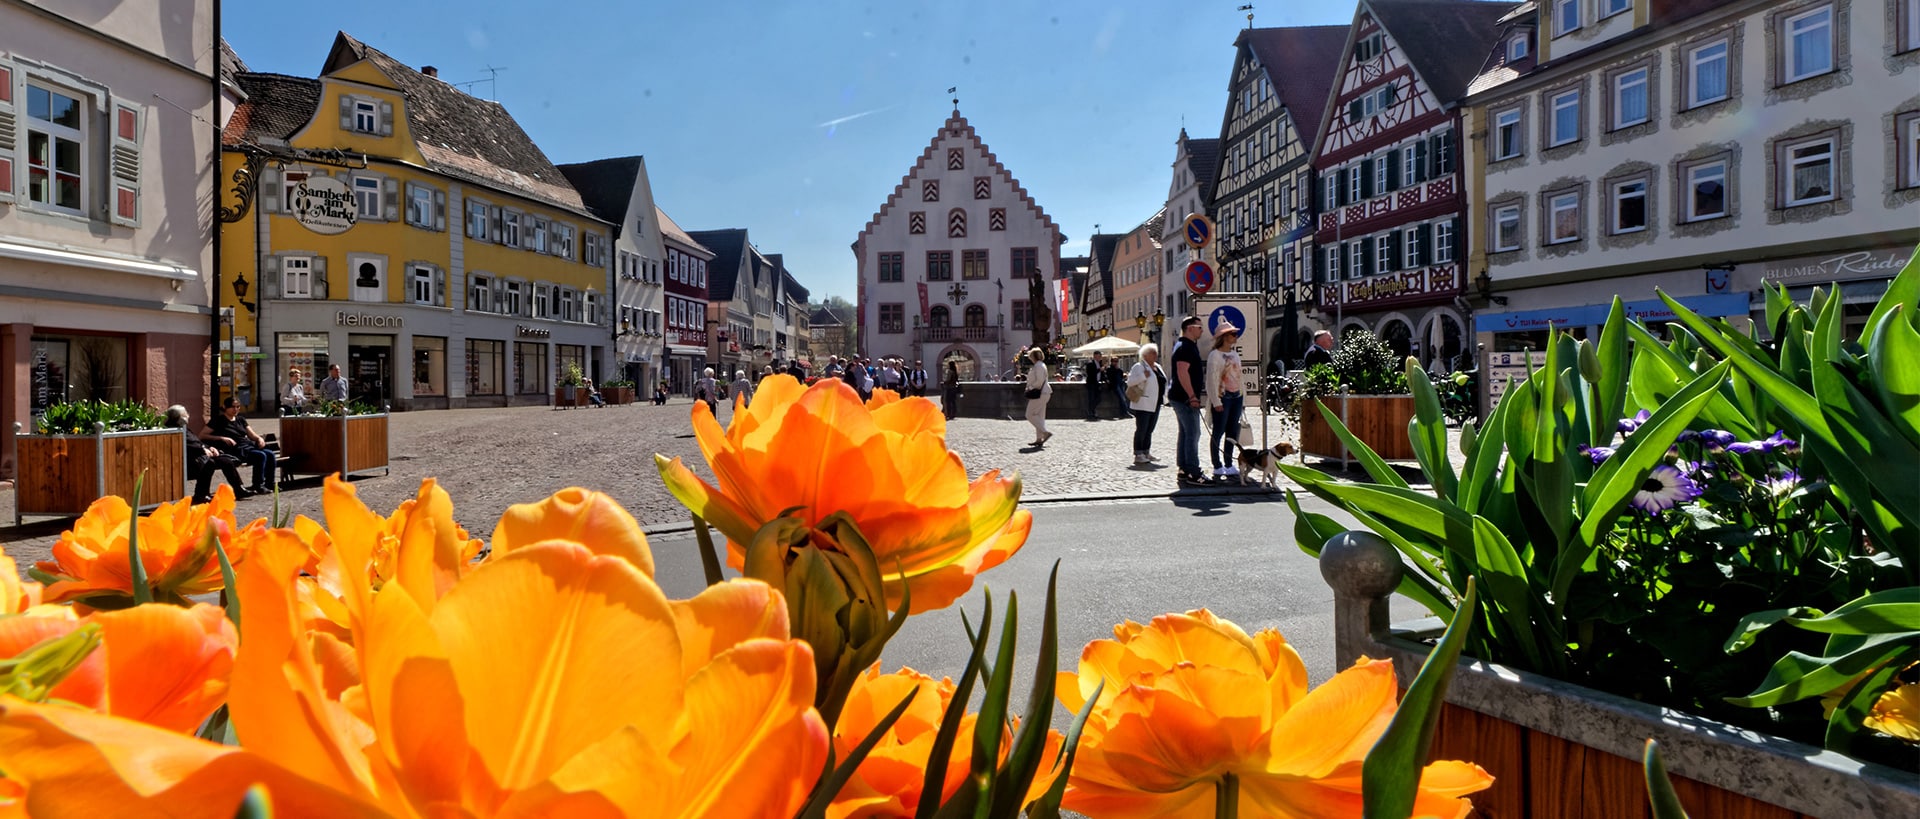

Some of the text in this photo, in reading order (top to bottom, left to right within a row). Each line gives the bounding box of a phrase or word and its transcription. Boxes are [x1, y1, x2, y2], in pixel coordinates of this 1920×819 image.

[297, 183, 357, 207] Sambeth
[324, 199, 344, 208] am
[310, 205, 356, 225] Markt
[1766, 251, 1909, 279] BLUMEN Rüde
